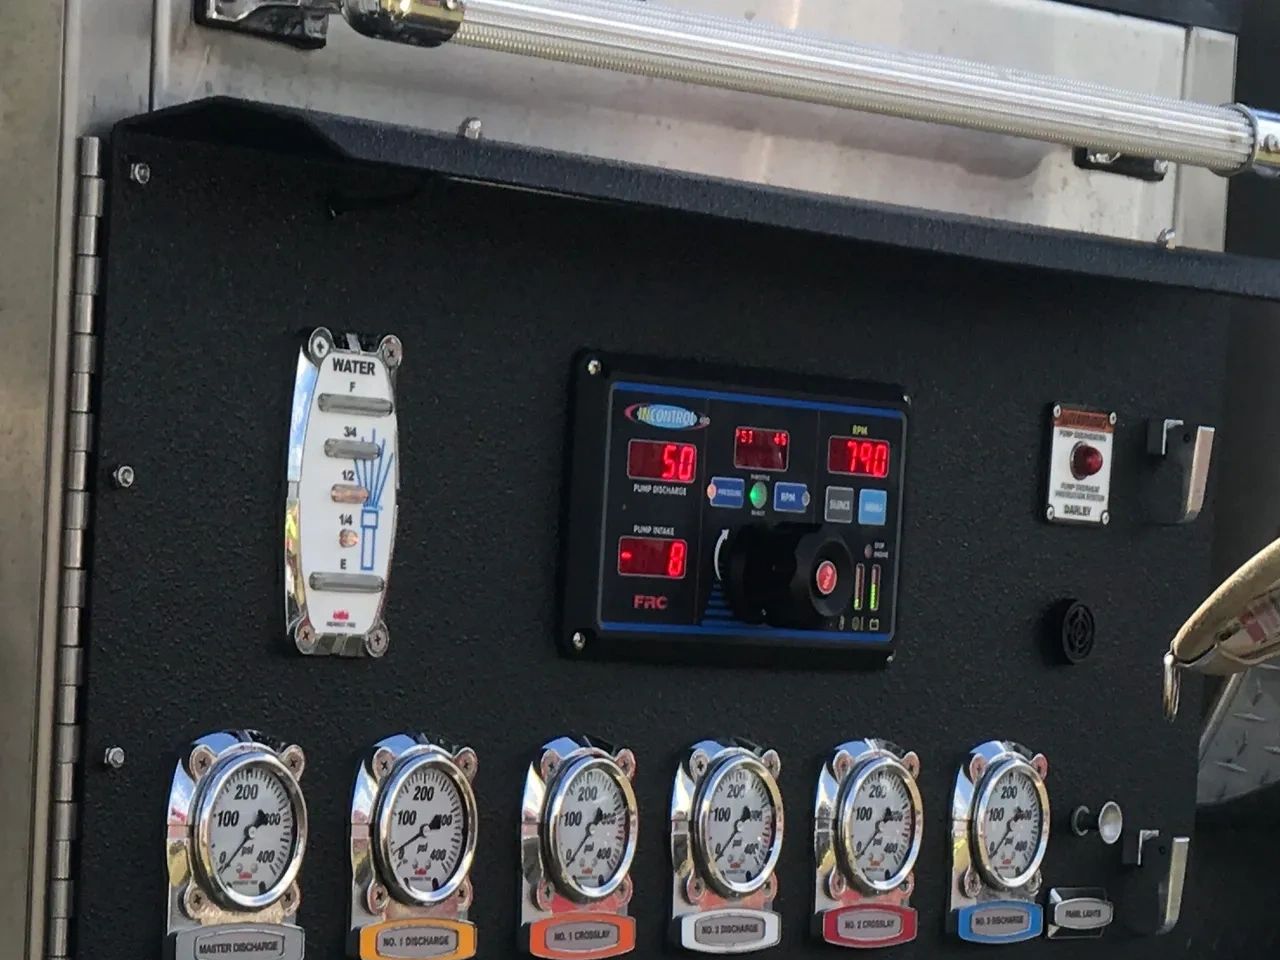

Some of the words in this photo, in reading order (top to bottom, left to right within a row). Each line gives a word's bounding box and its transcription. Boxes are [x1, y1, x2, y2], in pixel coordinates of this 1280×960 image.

[332, 357, 376, 376] WATER
[349, 382, 356, 393] F
[343, 426, 357, 438] 3/4
[662, 444, 694, 481] 50
[847, 441, 888, 478] 790
[341, 470, 355, 482] 1/2
[633, 483, 652, 494] PUMP
[338, 513, 352, 525] 1/4
[633, 524, 652, 534] PUMP
[340, 558, 347, 570] E
[633, 595, 668, 609] FRC
[234, 784, 258, 800] 200
[413, 786, 434, 801] 200
[578, 786, 598, 802] 200
[1001, 785, 1018, 800] 200
[217, 810, 240, 827] 100
[397, 810, 417, 826] 100
[563, 811, 582, 827] 100
[713, 807, 731, 822] 100
[855, 806, 873, 821] 100
[988, 807, 1004, 822] 100
[256, 850, 275, 864] 400
[430, 848, 447, 861] 400
[862, 918, 895, 930] CROSSLAY
[991, 914, 1024, 926] DISCHARGE
[554, 930, 566, 941] NO.
[574, 929, 611, 941] CROSSLAY
[701, 924, 714, 935] NO.
[720, 923, 759, 935] DISCHARGE
[199, 942, 232, 954] MASTER
[233, 940, 279, 953] DISCHARGE
[383, 936, 397, 947] NO.
[405, 934, 449, 946] DISCHARGE
